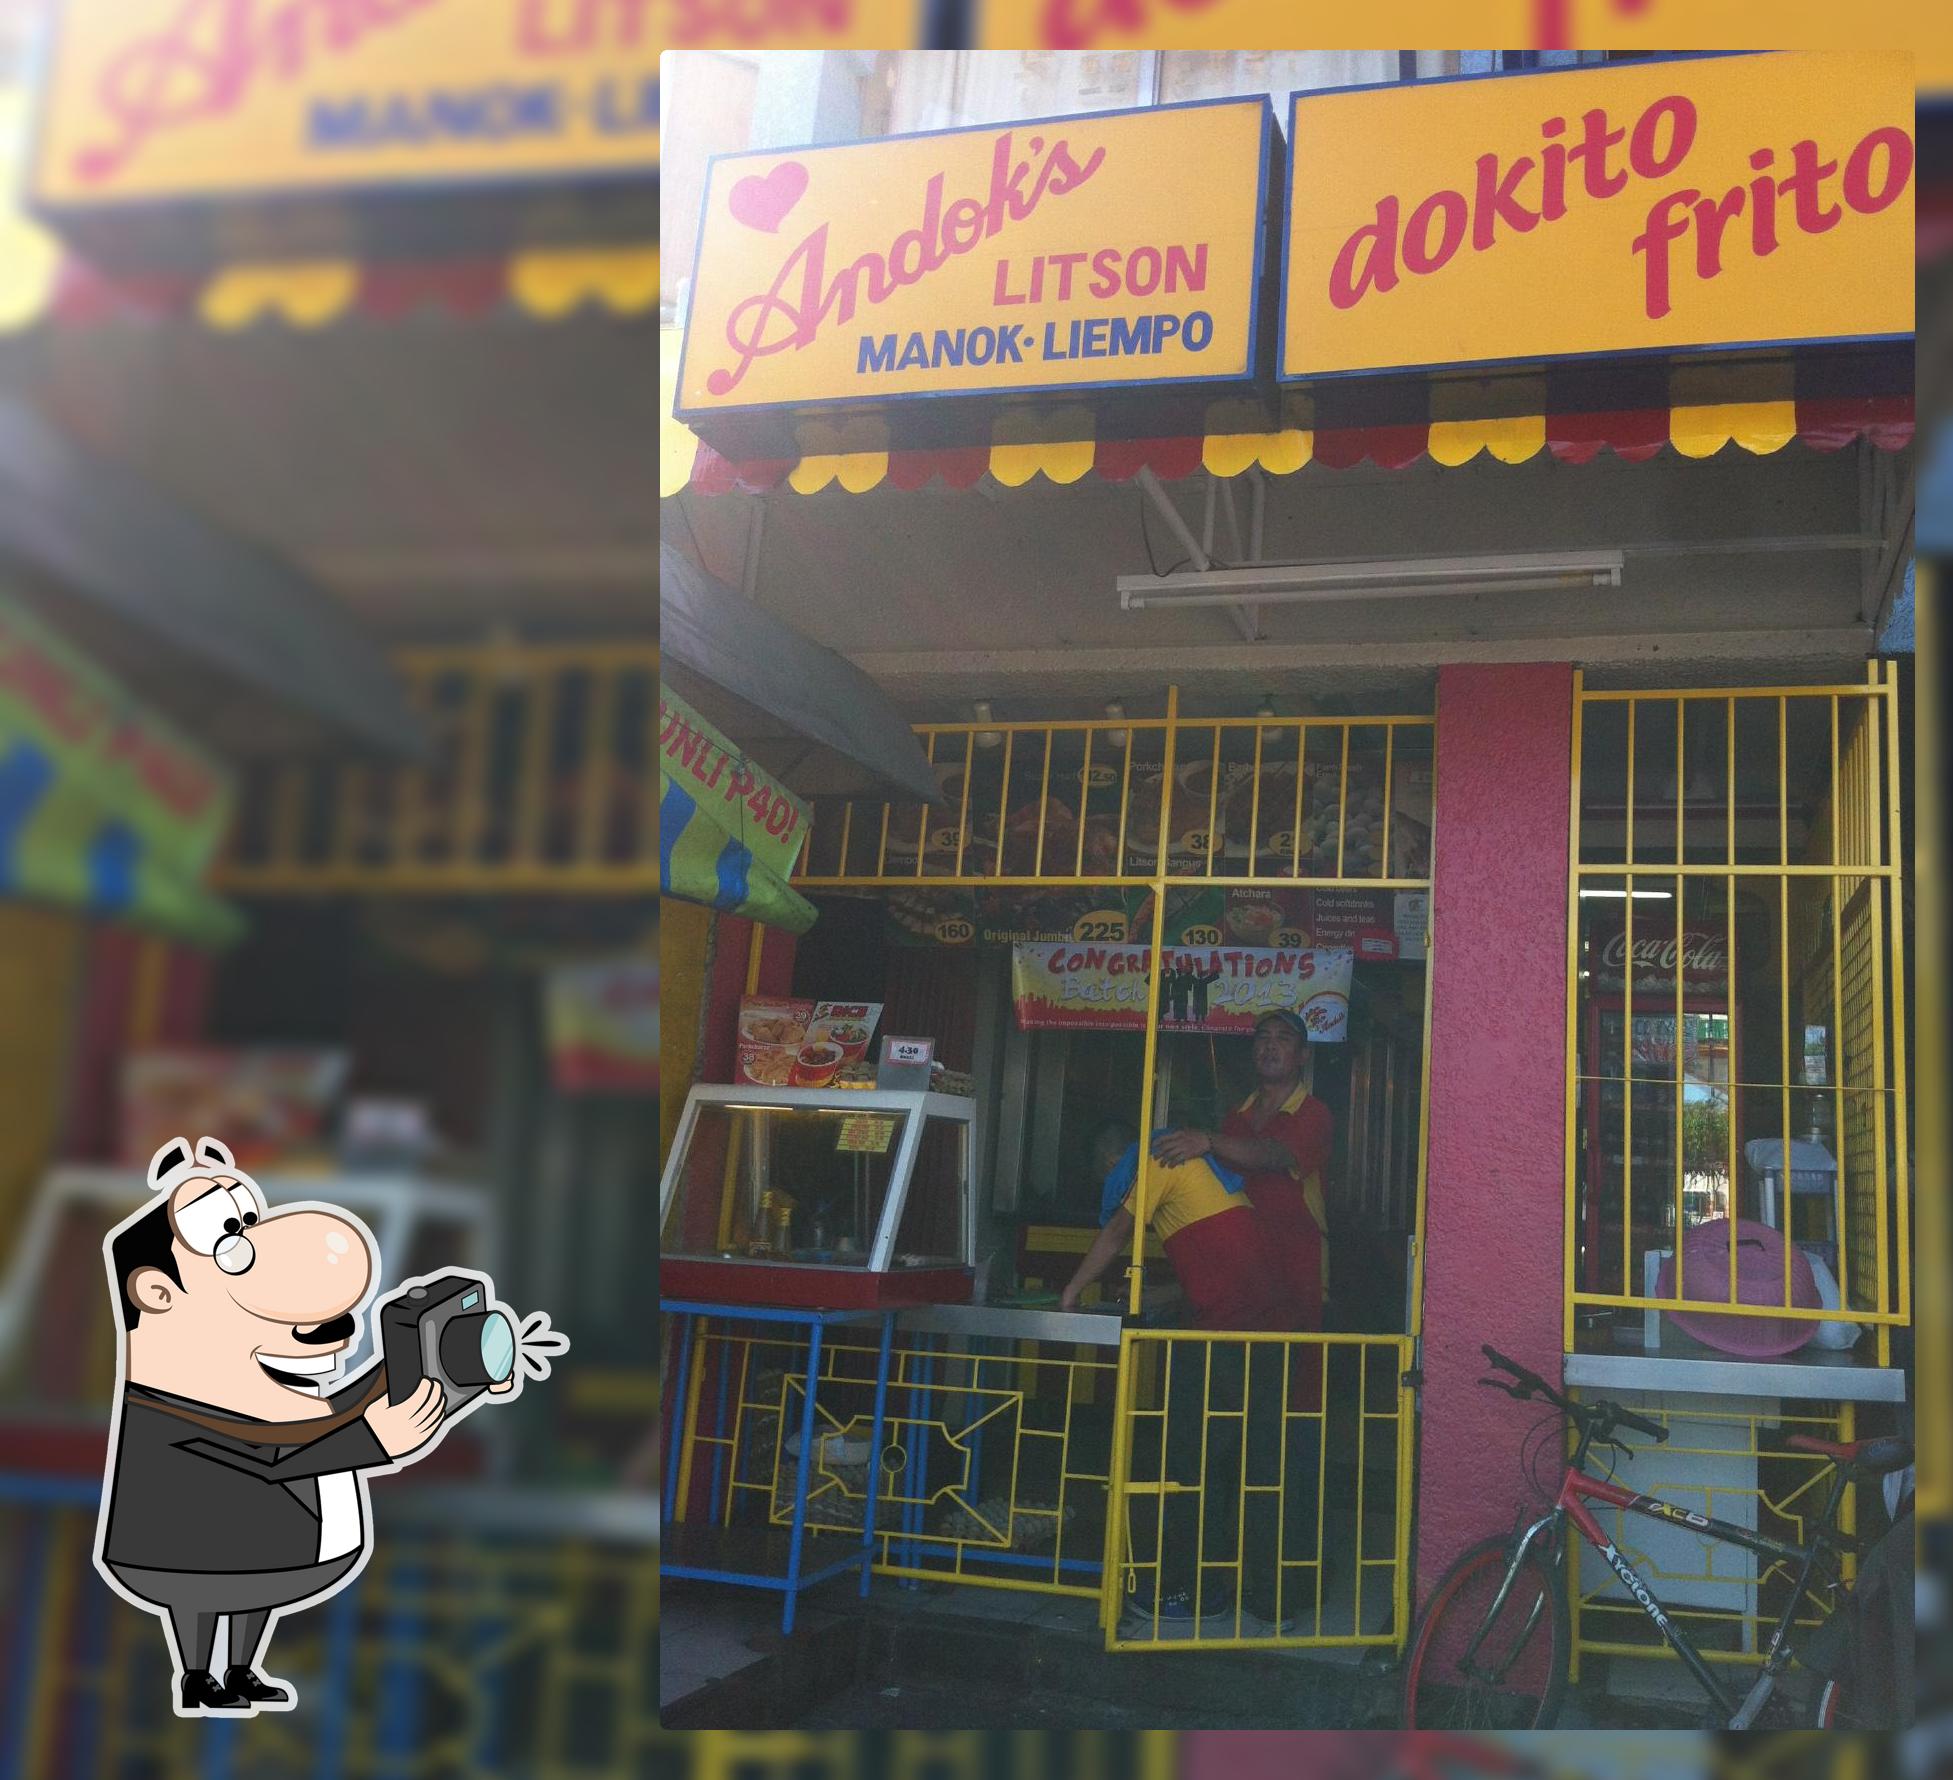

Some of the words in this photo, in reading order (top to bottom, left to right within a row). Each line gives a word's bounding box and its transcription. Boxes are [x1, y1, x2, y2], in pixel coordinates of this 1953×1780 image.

[1328, 95, 1698, 309] dokito
[1632, 127, 1915, 319] frito
[706, 131, 1106, 396] Andok's
[993, 243, 1209, 307] LITSON
[1043, 310, 1214, 361] LIEMPO
[938, 923, 970, 938] 160
[983, 927, 1030, 944] Original
[1079, 922, 1126, 943] 225
[1185, 930, 1219, 945] 130
